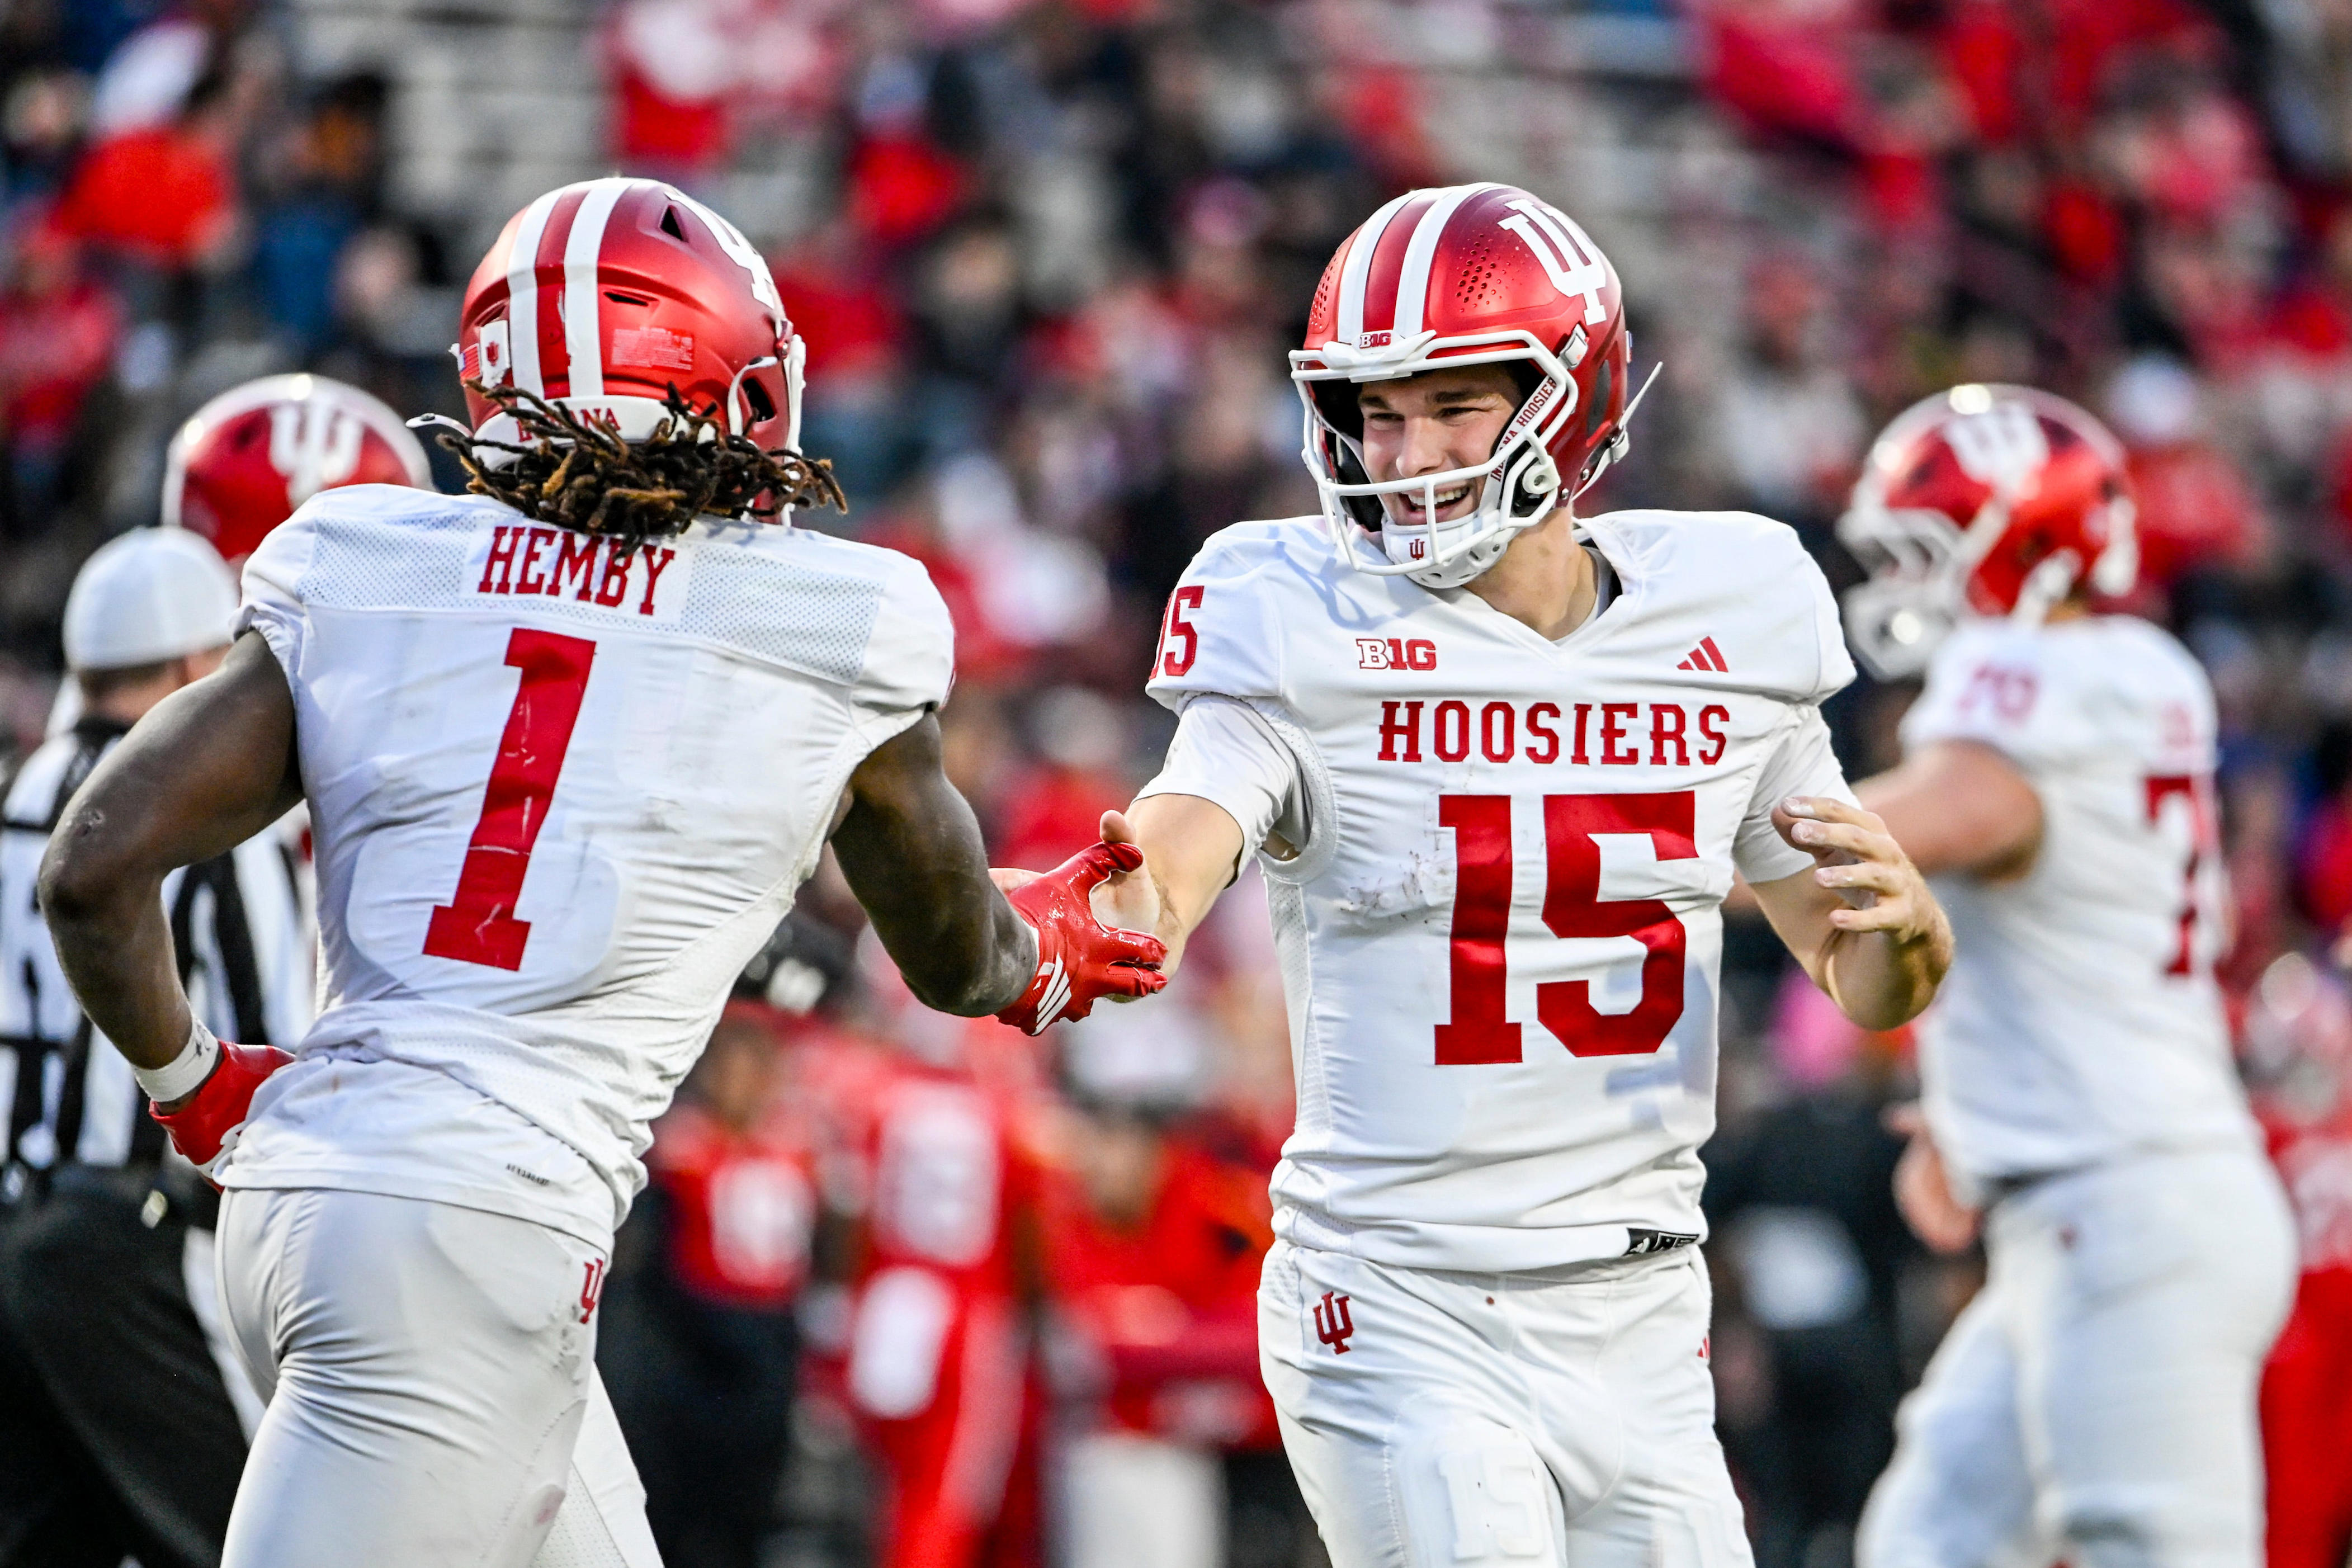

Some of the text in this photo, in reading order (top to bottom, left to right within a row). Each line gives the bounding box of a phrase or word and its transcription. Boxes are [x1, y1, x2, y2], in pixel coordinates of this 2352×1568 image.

[1516, 376, 1557, 427] HOOSIER
[478, 526, 675, 616] HEMBY
[1149, 585, 1205, 680] 15
[1377, 700, 1731, 766] HOOSIERS
[422, 627, 597, 972] 1
[1433, 790, 1699, 1065] 15
